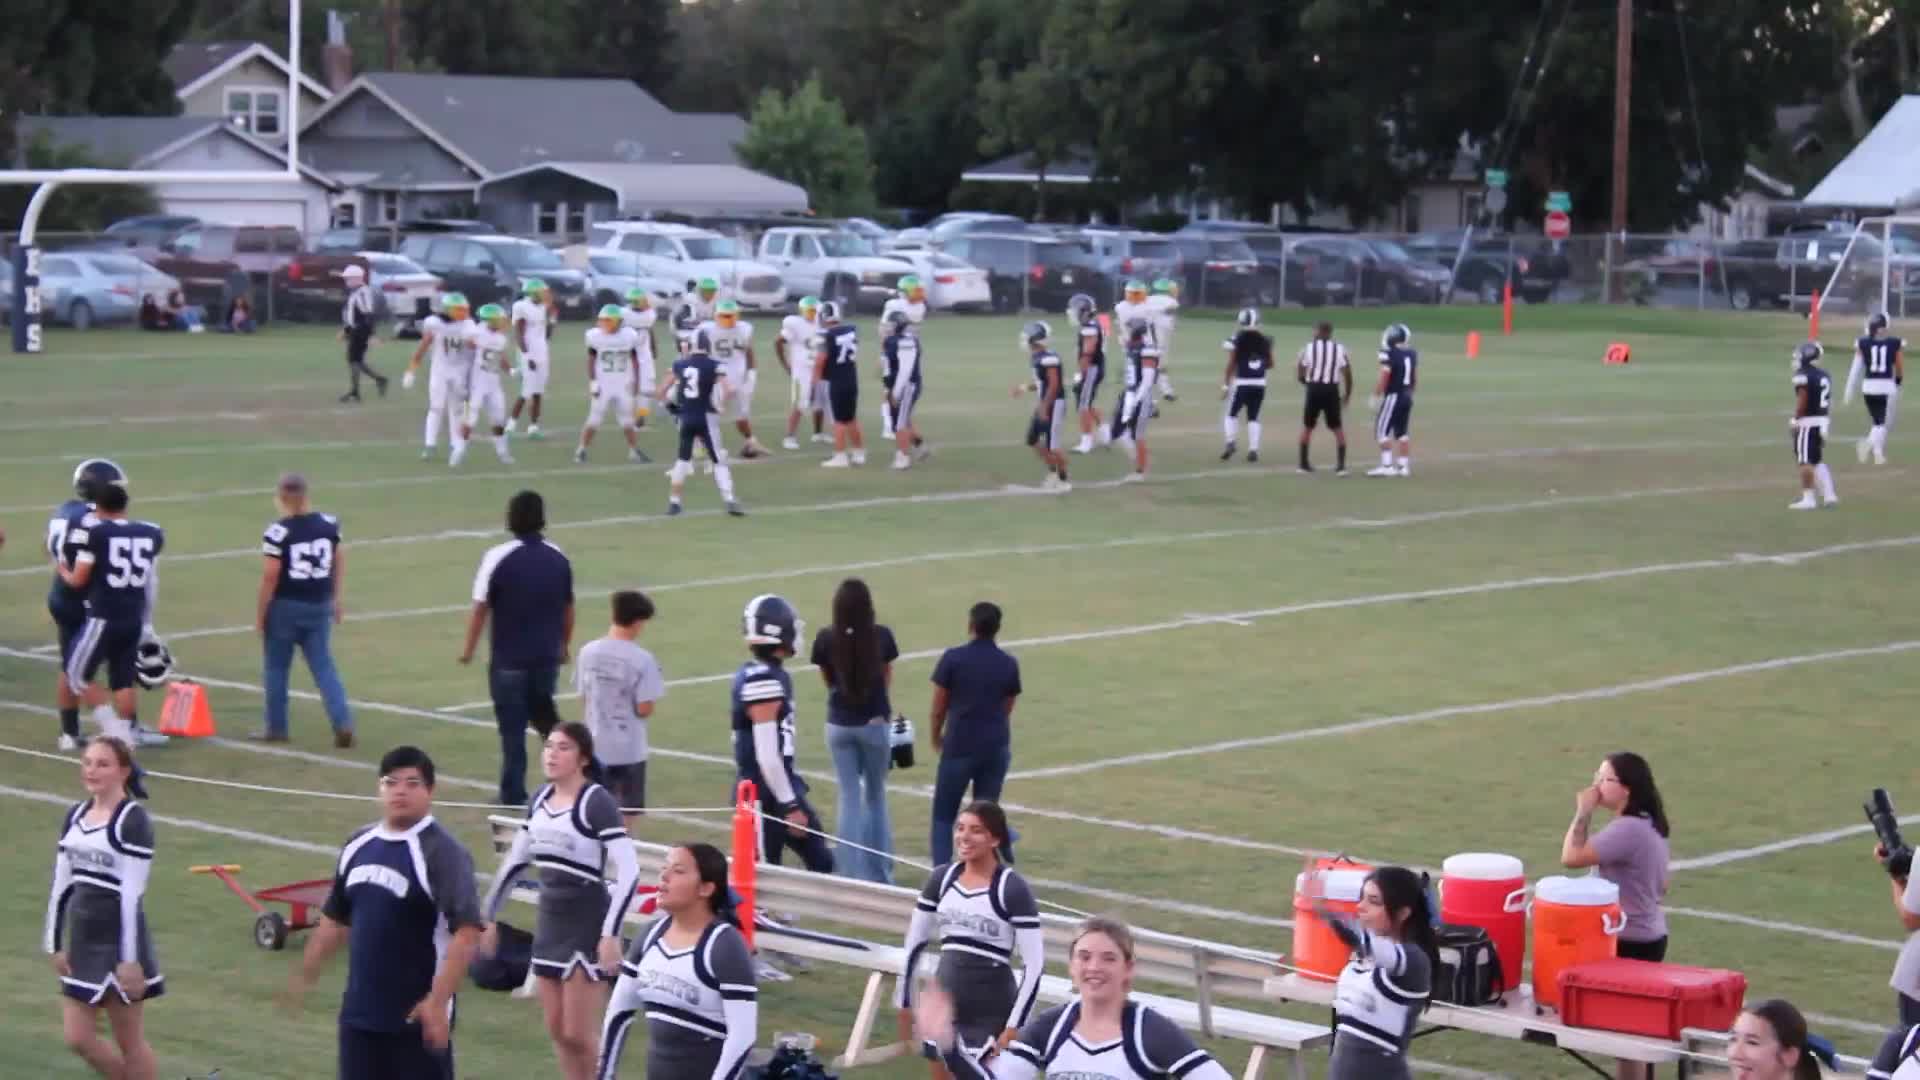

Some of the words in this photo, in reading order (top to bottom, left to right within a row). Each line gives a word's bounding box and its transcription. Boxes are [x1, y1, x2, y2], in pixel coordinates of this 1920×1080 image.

[1402, 356, 1412, 386] 1
[1870, 345, 1888, 373] 11
[683, 367, 700, 399] 3
[1819, 377, 1831, 408] 2
[106, 536, 154, 589] 55
[288, 537, 333, 579] 53
